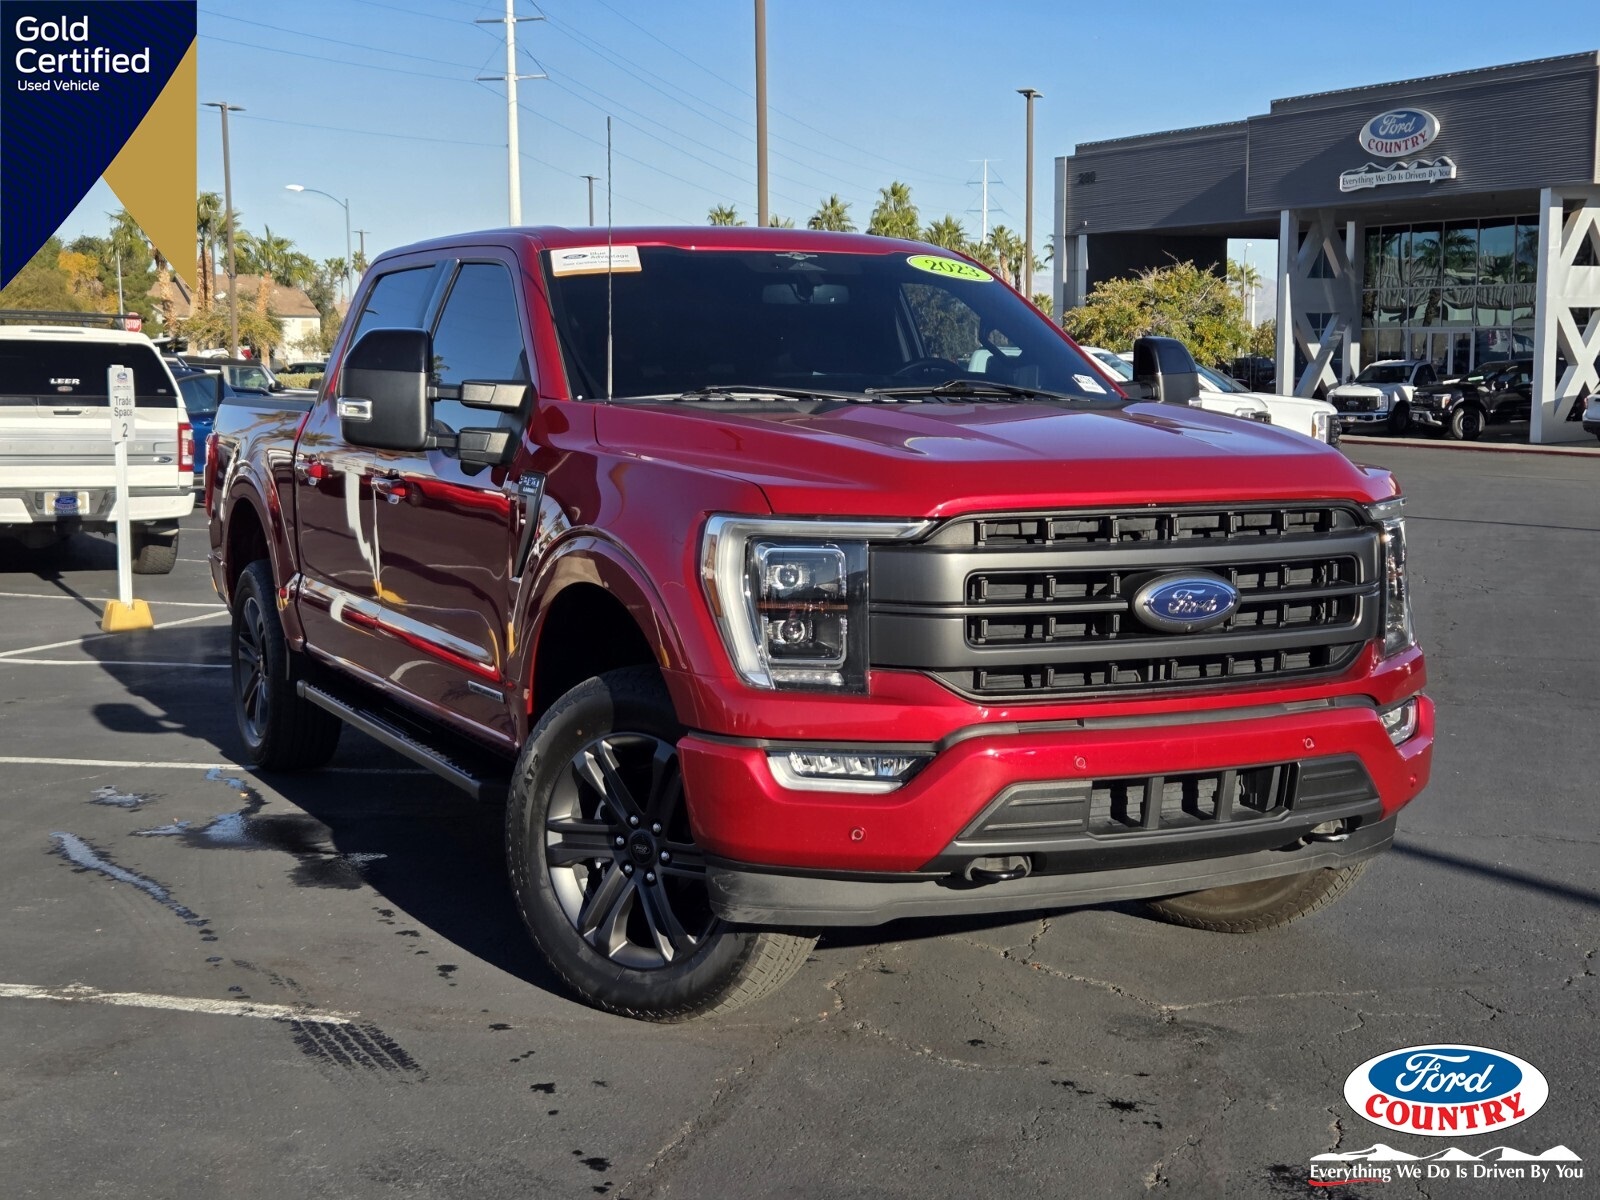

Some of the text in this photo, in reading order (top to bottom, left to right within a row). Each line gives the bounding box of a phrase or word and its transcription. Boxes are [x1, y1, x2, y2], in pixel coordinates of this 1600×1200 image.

[1378, 113, 1416, 136] Ford
[1367, 130, 1428, 153] COUNTRY
[1342, 174, 1374, 186] Everything
[1375, 174, 1385, 183] We
[1387, 173, 1397, 181] Do
[1399, 172, 1405, 180] Is
[1405, 170, 1427, 180] Driven
[1428, 169, 1437, 179] By
[925, 259, 980, 278] 2023
[127, 319, 141, 329] STOP
[114, 396, 132, 406] Trade
[114, 407, 133, 419] Space
[122, 423, 128, 438] 2
[1168, 588, 1218, 614] Ford
